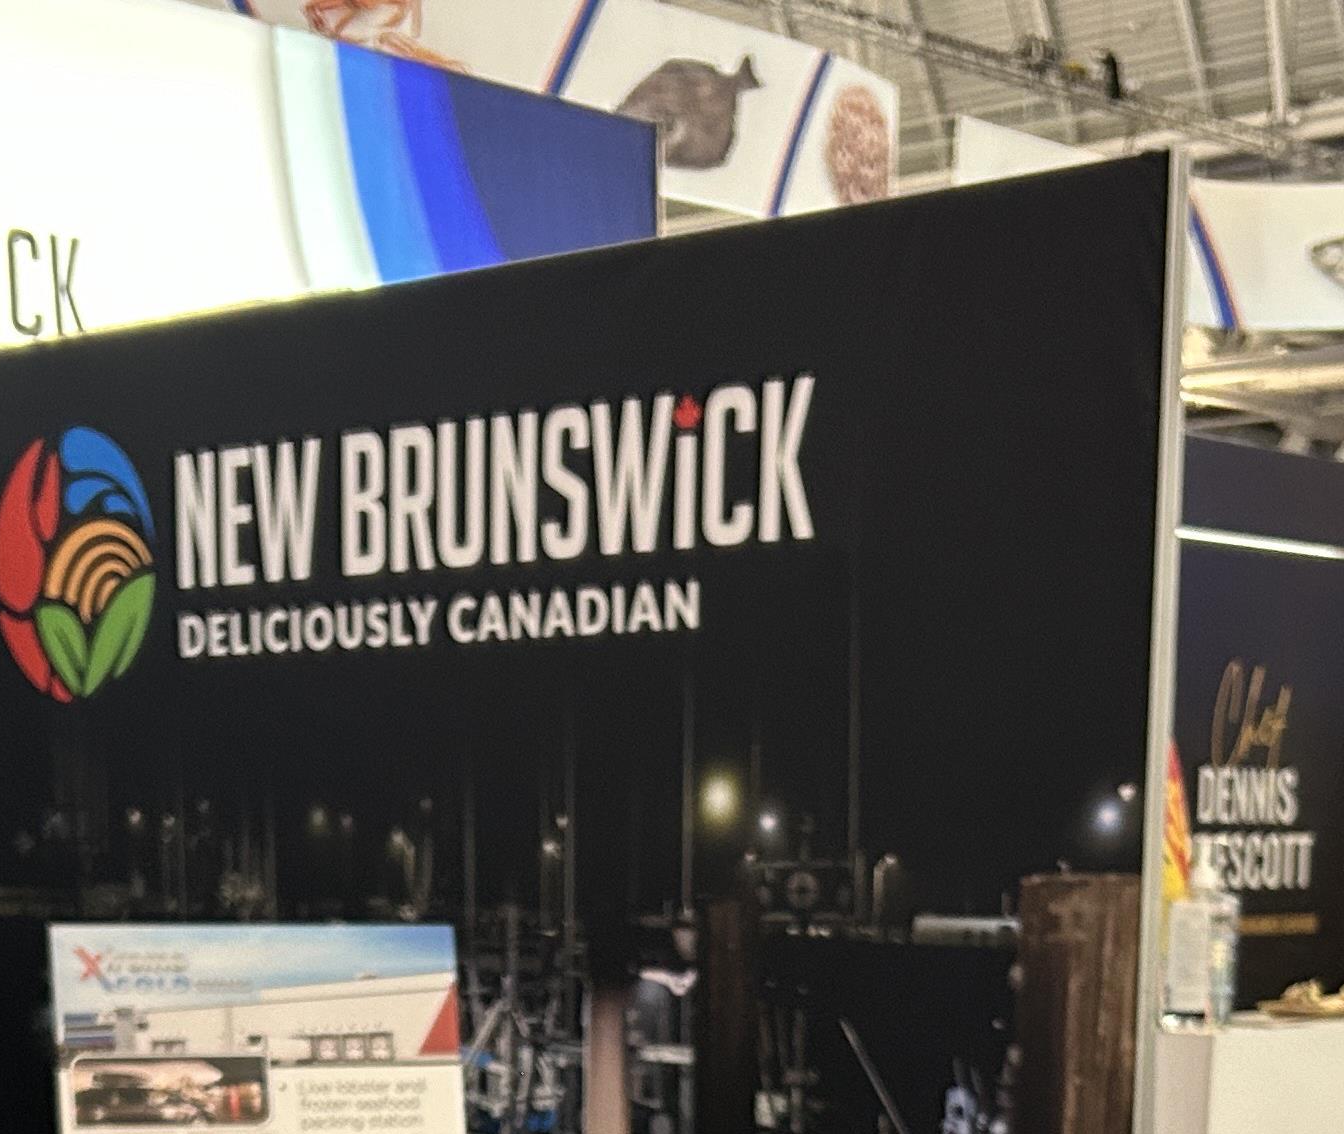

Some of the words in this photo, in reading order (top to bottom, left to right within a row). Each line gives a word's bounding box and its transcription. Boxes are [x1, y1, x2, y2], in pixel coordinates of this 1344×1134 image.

[172, 434, 322, 591] NEW
[178, 598, 439, 660] DELICIOUSLY
[447, 580, 701, 645] CANADIAN
[1196, 766, 1299, 827] DENNIS
